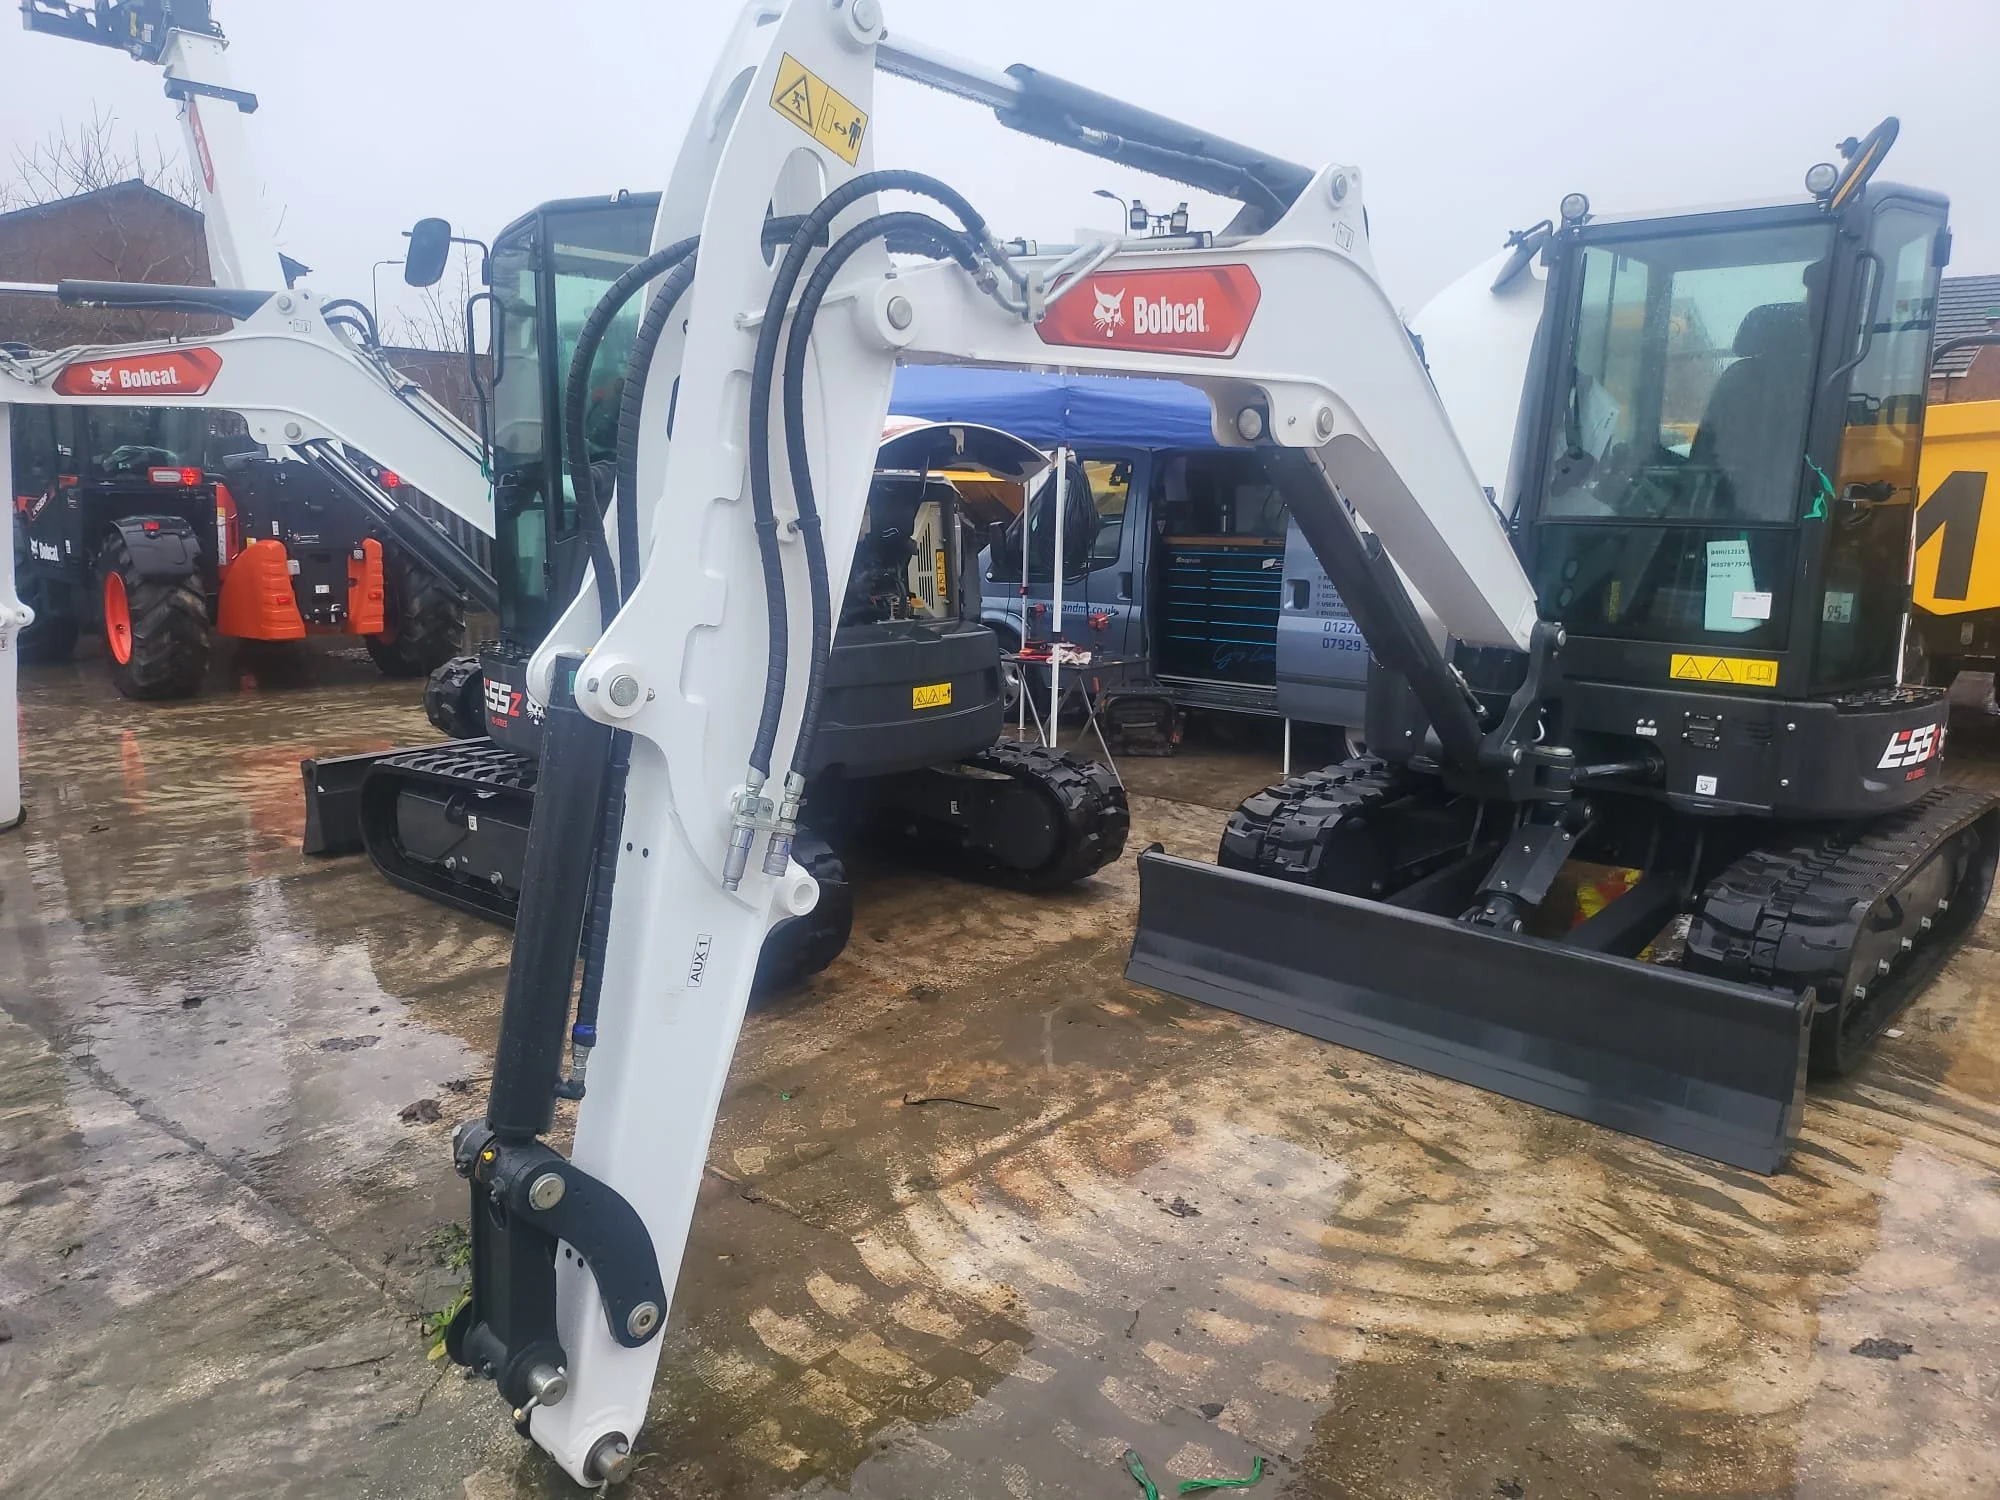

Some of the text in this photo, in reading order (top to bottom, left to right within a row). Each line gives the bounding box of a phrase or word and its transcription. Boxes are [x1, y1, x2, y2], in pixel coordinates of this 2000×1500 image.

[1133, 296, 1206, 334] Bobcat
[119, 366, 178, 388] Bobcat
[1322, 638, 1361, 652] 07929
[690, 951, 706, 982] AUX
